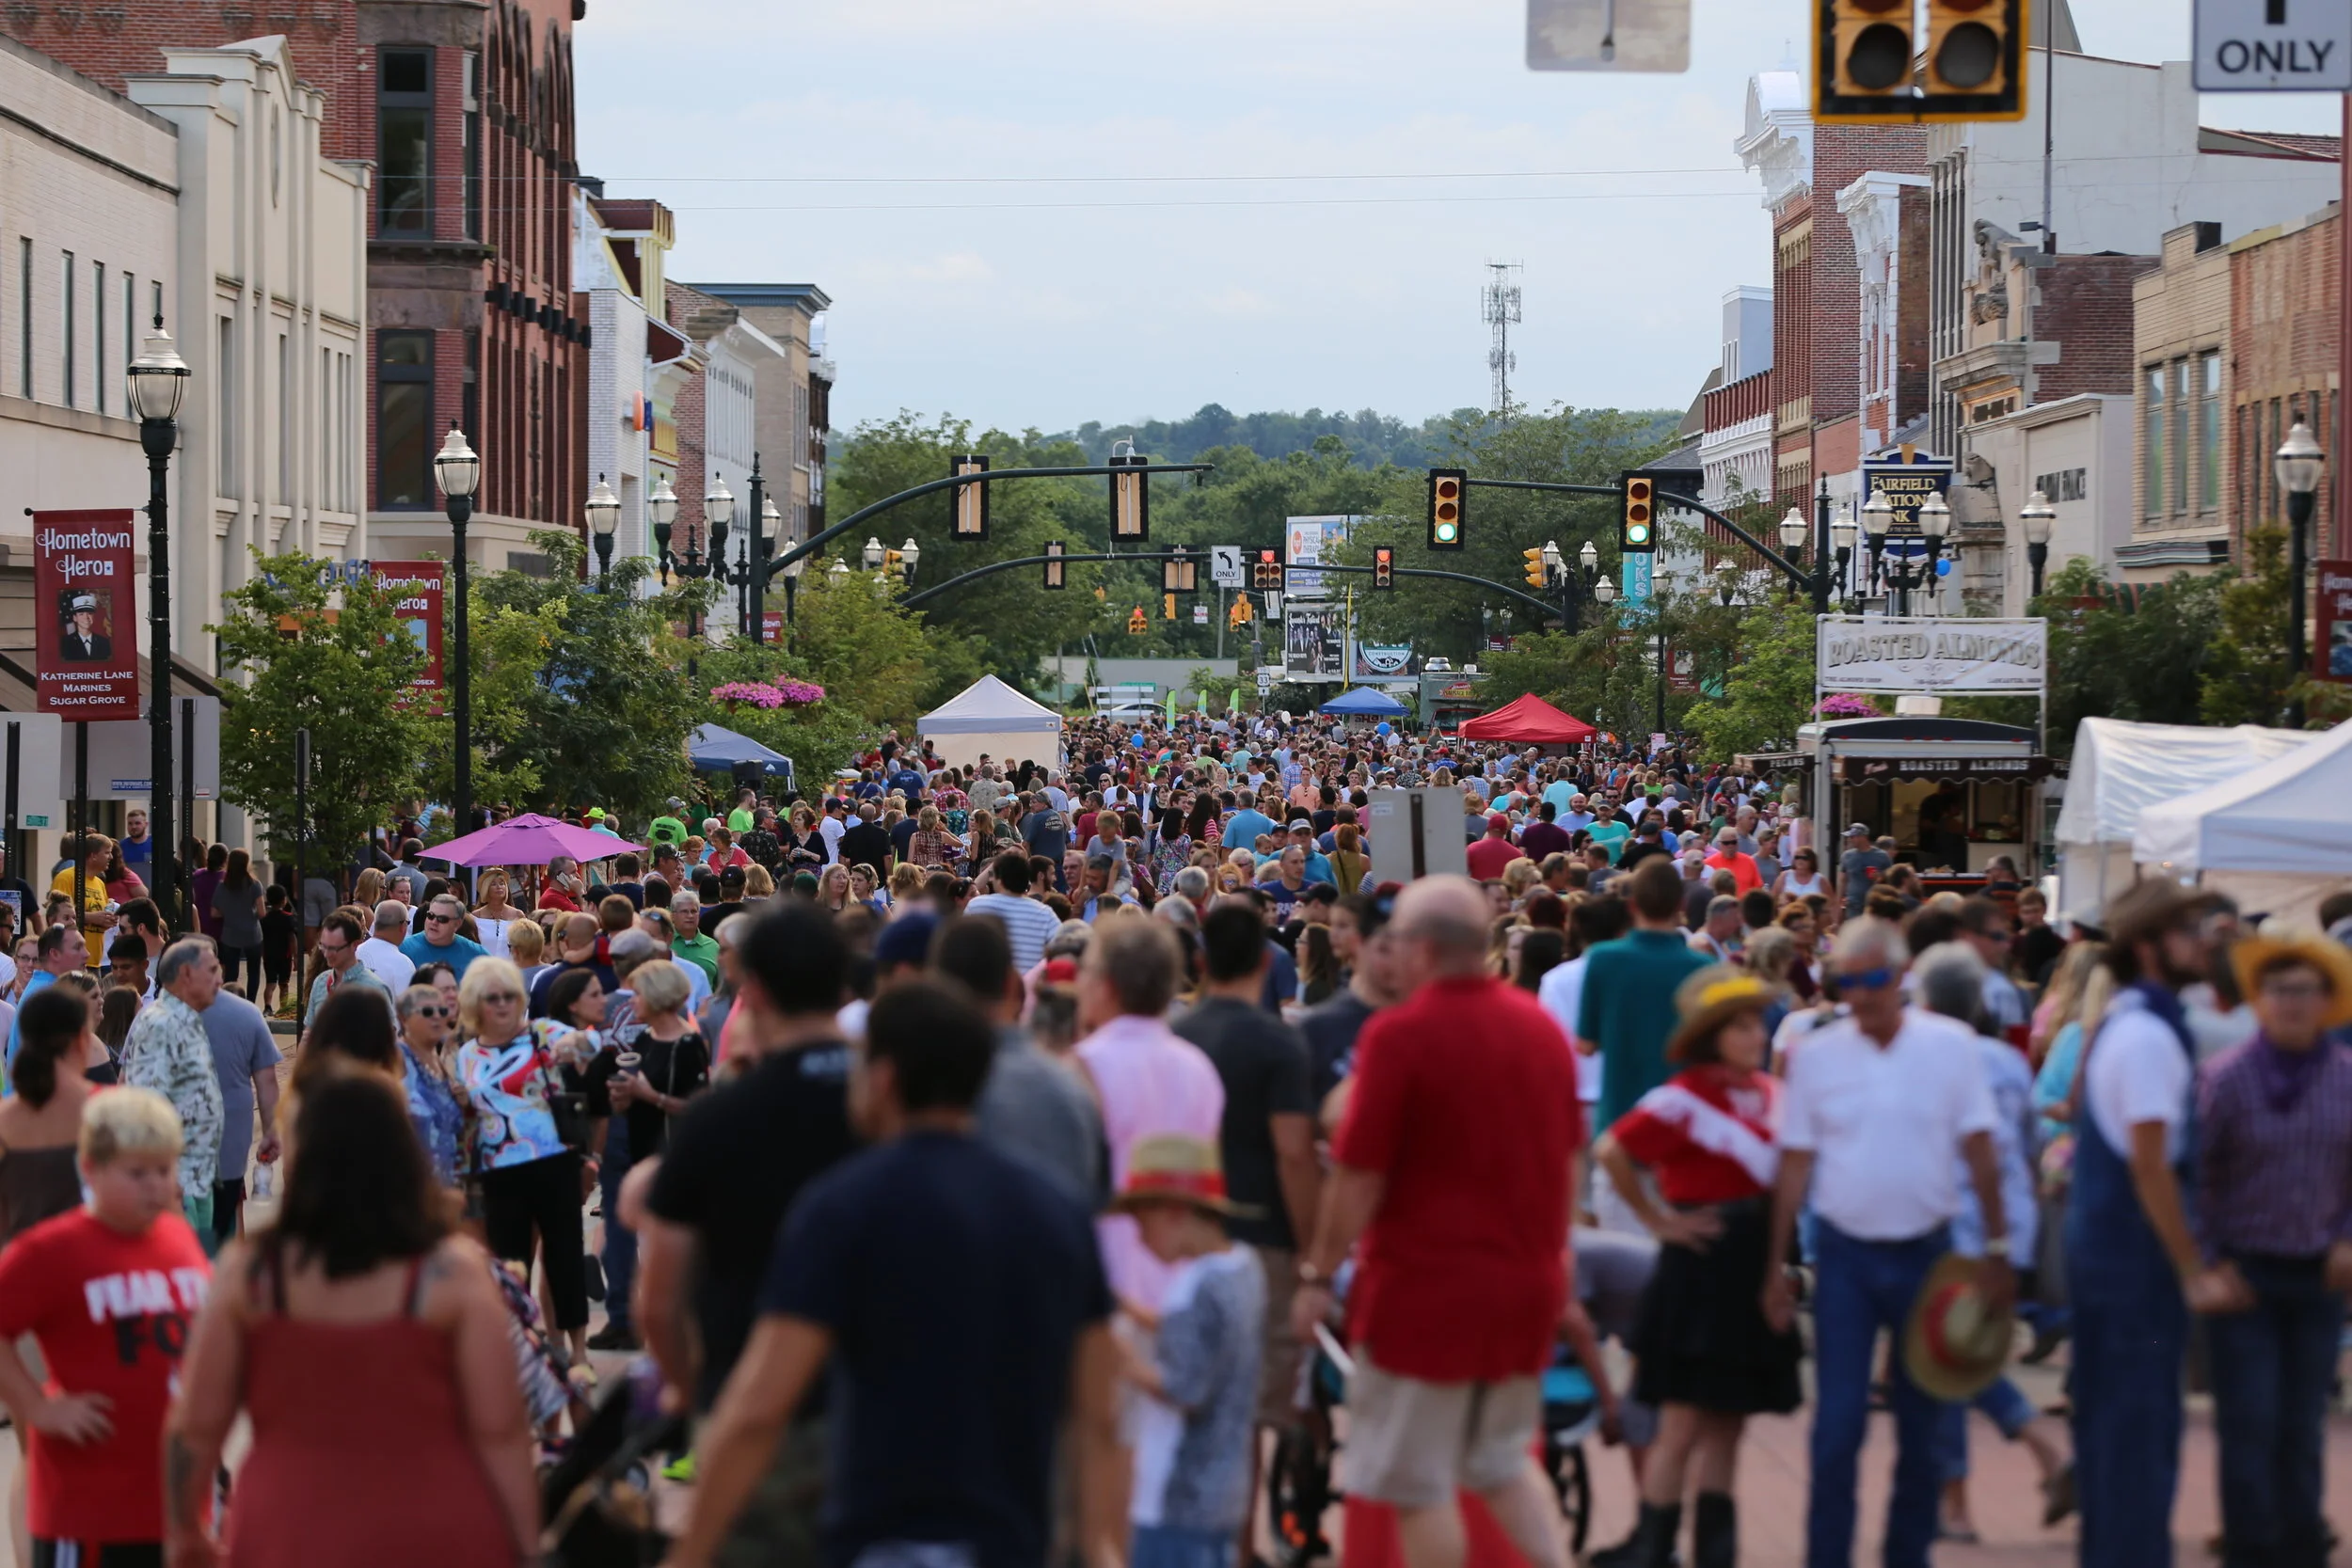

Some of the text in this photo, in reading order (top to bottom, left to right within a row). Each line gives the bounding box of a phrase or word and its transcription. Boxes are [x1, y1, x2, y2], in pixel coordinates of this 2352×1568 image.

[2217, 40, 2334, 73] ONLY
[1870, 477, 1935, 490] FAIRFIELD
[1885, 494, 1927, 506] ATION
[36, 528, 130, 558] Hometown
[56, 554, 103, 584] Hero
[1828, 632, 2040, 670] ROASTED ALMONDS
[40, 671, 134, 681] KATHERINE LANE
[63, 684, 112, 692] MARINES
[50, 696, 126, 705] SUGAR GROVE
[1770, 758, 1804, 768] PECANS
[1899, 761, 1960, 770] ROASTED
[1970, 760, 2028, 770] ALMONDS
[84, 1271, 173, 1324] FEAR
